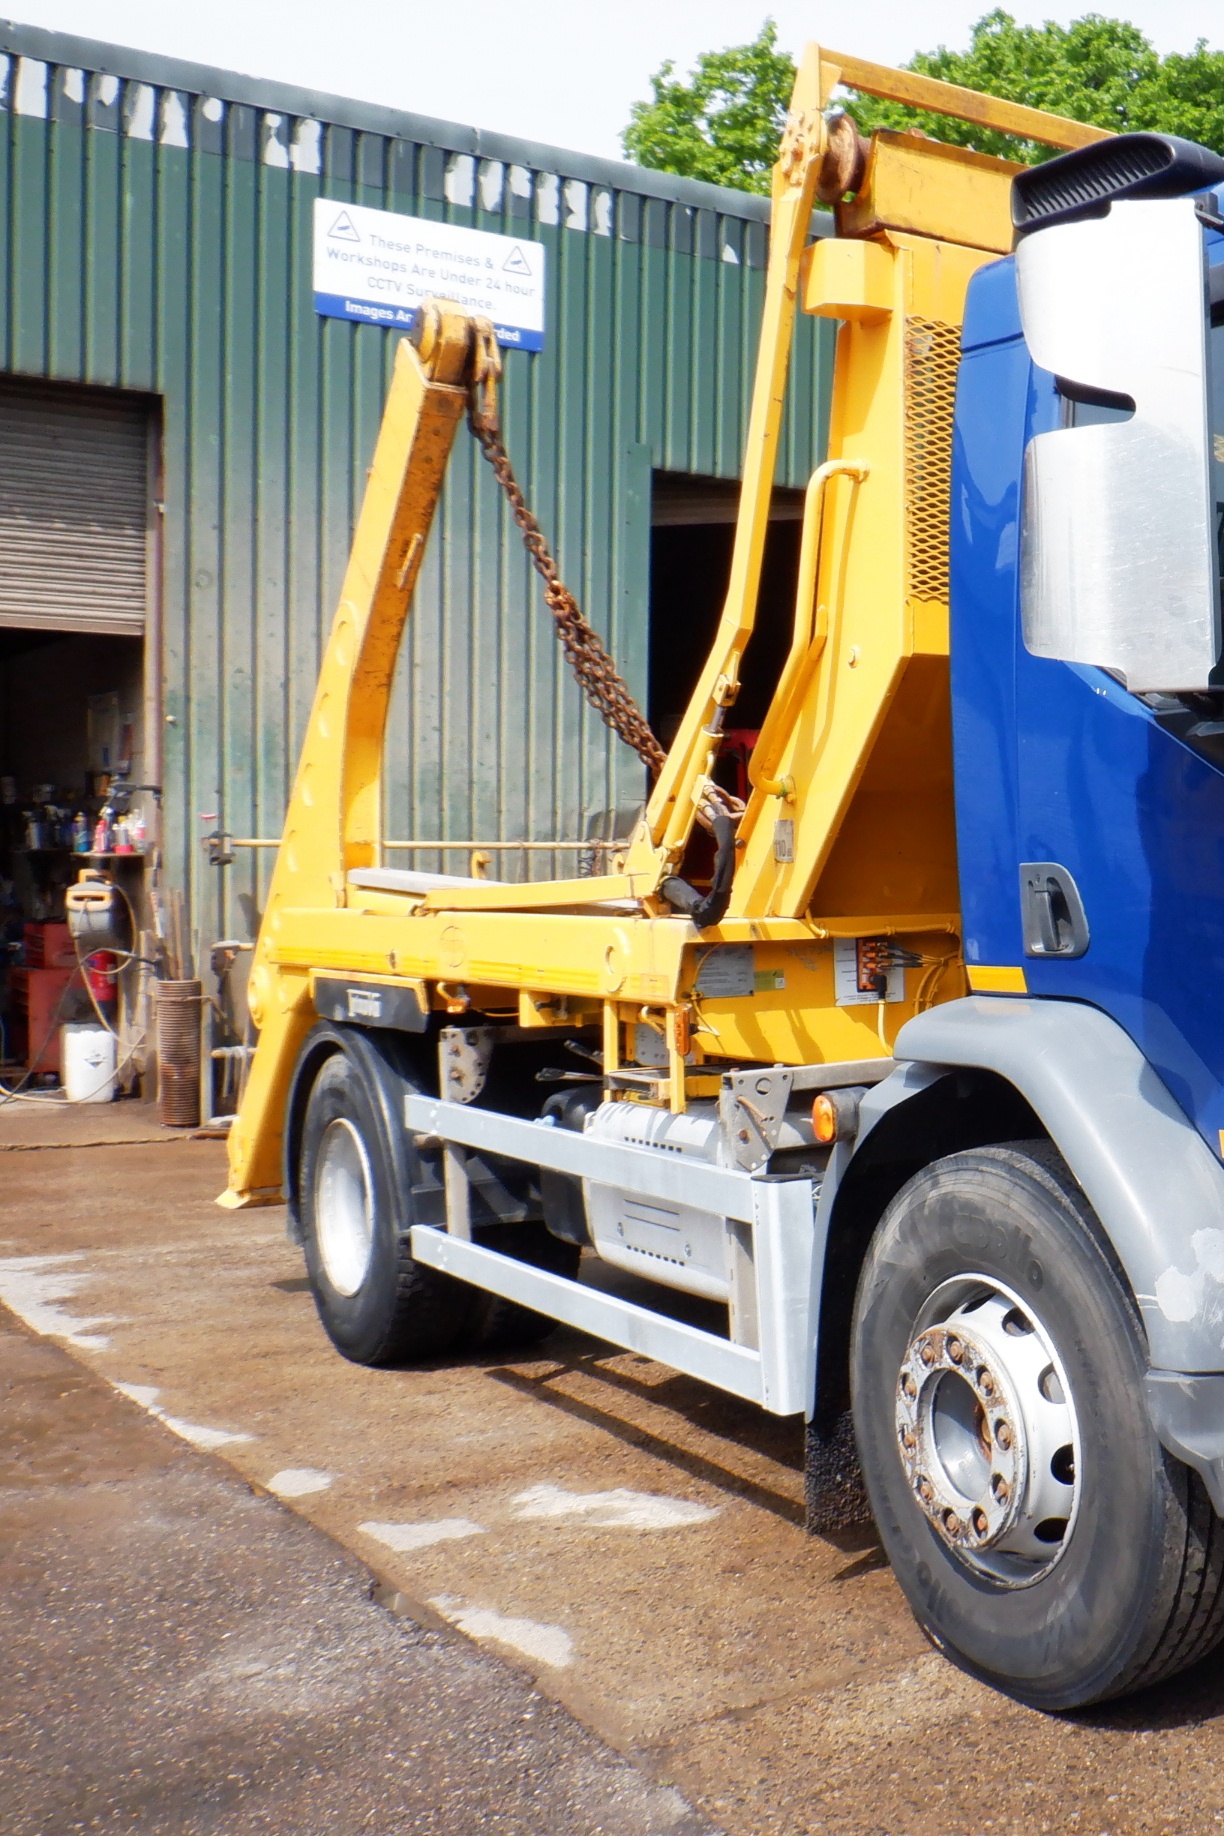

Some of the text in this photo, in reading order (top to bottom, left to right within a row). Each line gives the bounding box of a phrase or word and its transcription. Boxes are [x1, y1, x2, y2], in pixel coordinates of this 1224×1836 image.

[370, 234, 495, 270] These Premises &
[326, 246, 535, 297] Workshops Are Under 24 hour
[367, 276, 403, 293] CCTV
[345, 300, 394, 321] Images
[396, 309, 413, 323] Ar
